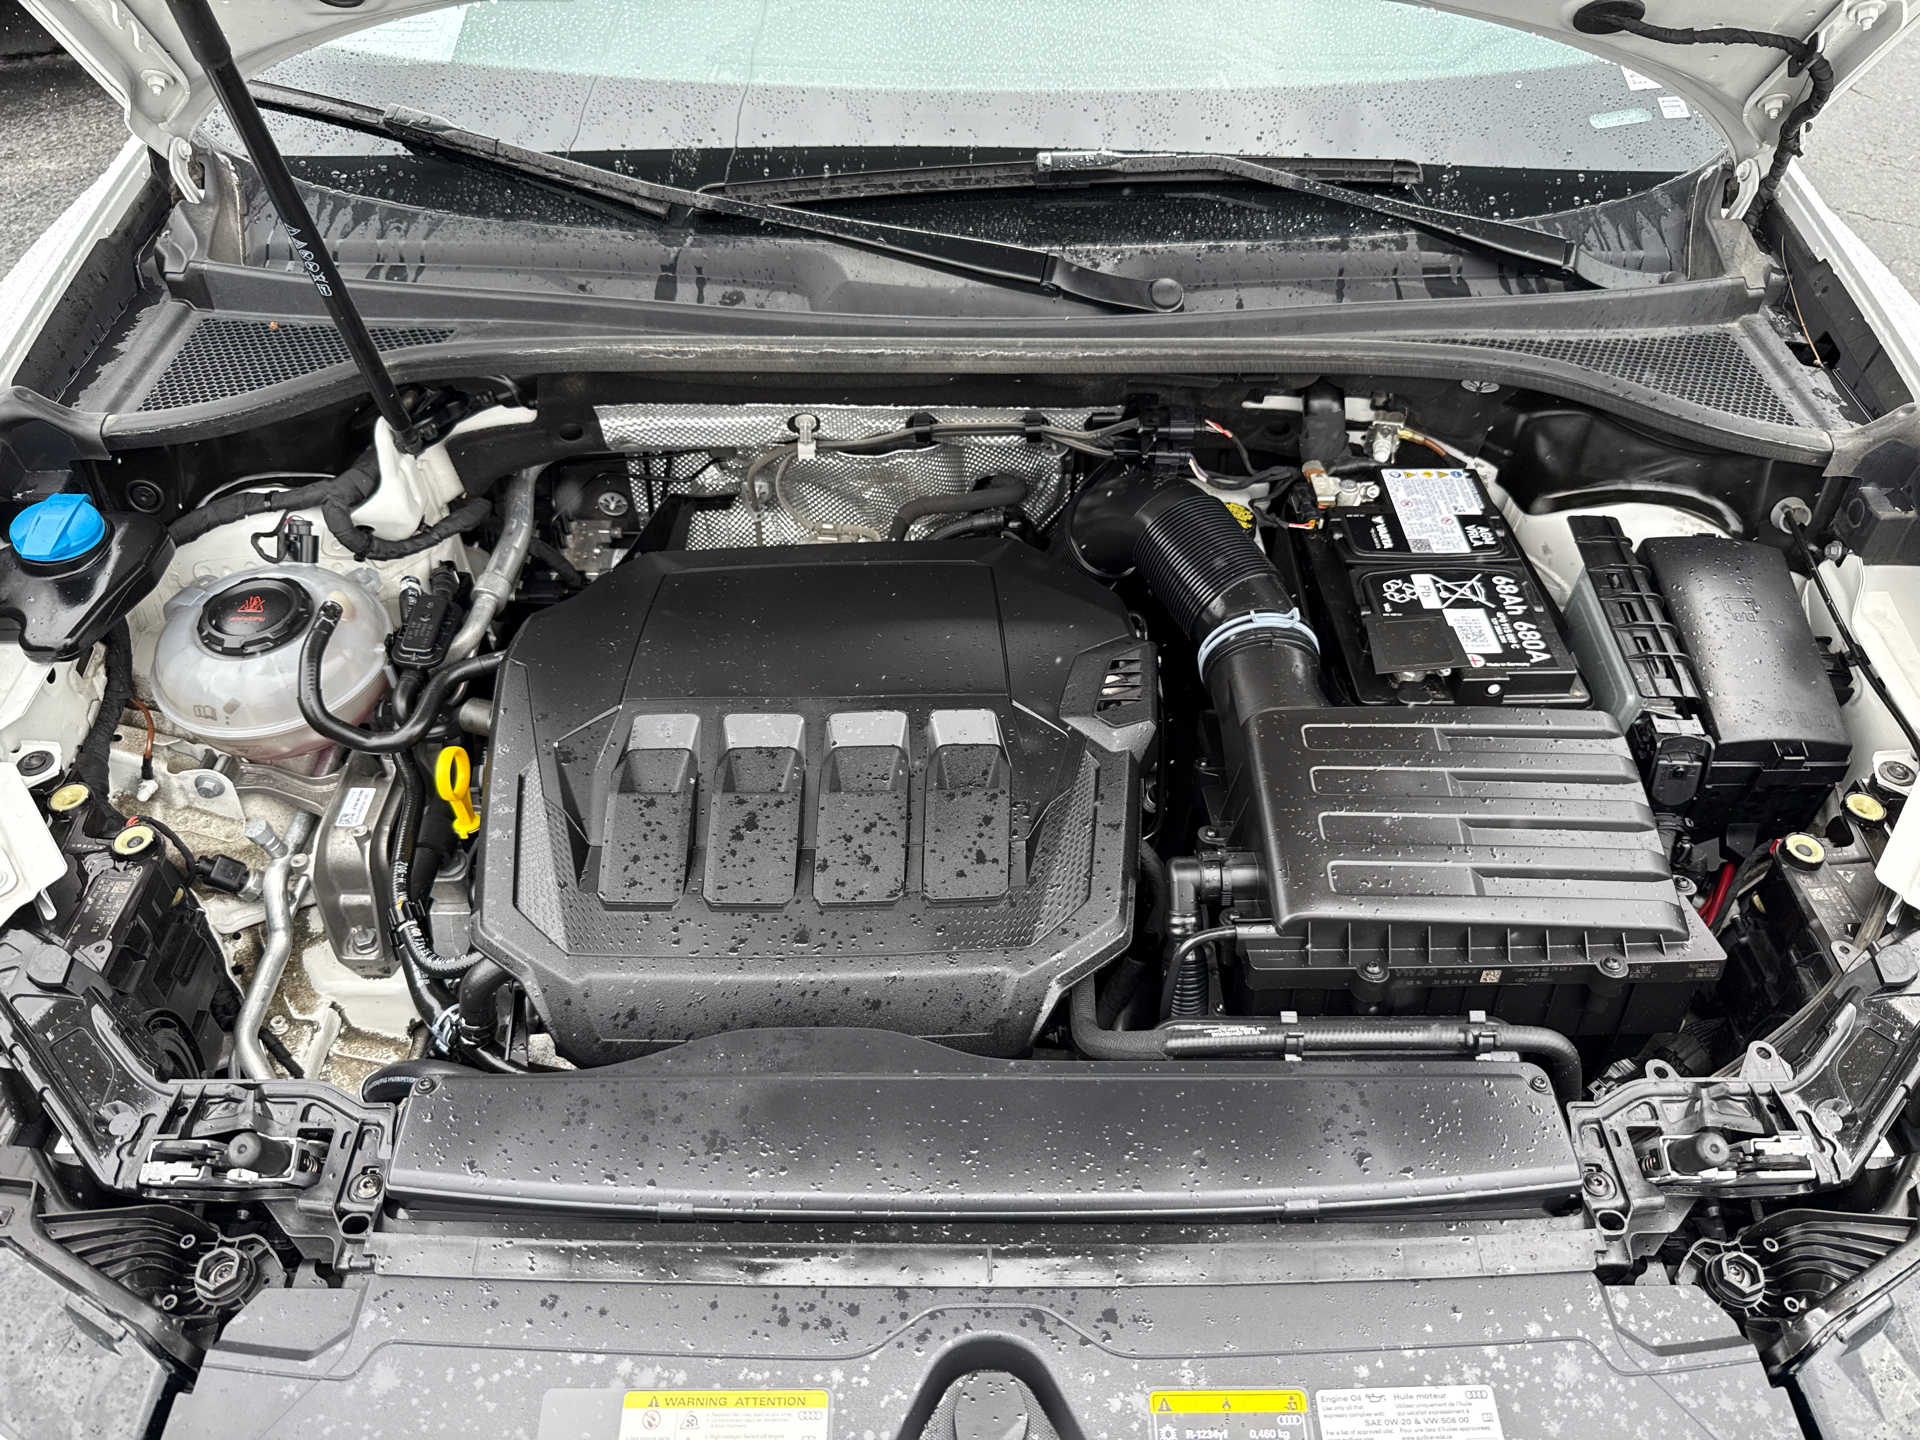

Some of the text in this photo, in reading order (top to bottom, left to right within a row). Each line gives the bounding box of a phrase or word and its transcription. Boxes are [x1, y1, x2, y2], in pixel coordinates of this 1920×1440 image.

[1376, 523, 1394, 549] VARTA
[1464, 524, 1484, 547] VRLA
[1476, 526, 1497, 545] AGM
[1418, 585, 1432, 597] Pb
[1492, 576, 1551, 663] 68Ah 680A
[664, 1396, 806, 1406] WARNING ATTENTION
[1320, 1395, 1348, 1403] Engine
[1185, 1429, 1229, 1440] R-1234yf
[1277, 1429, 1290, 1440] kg
